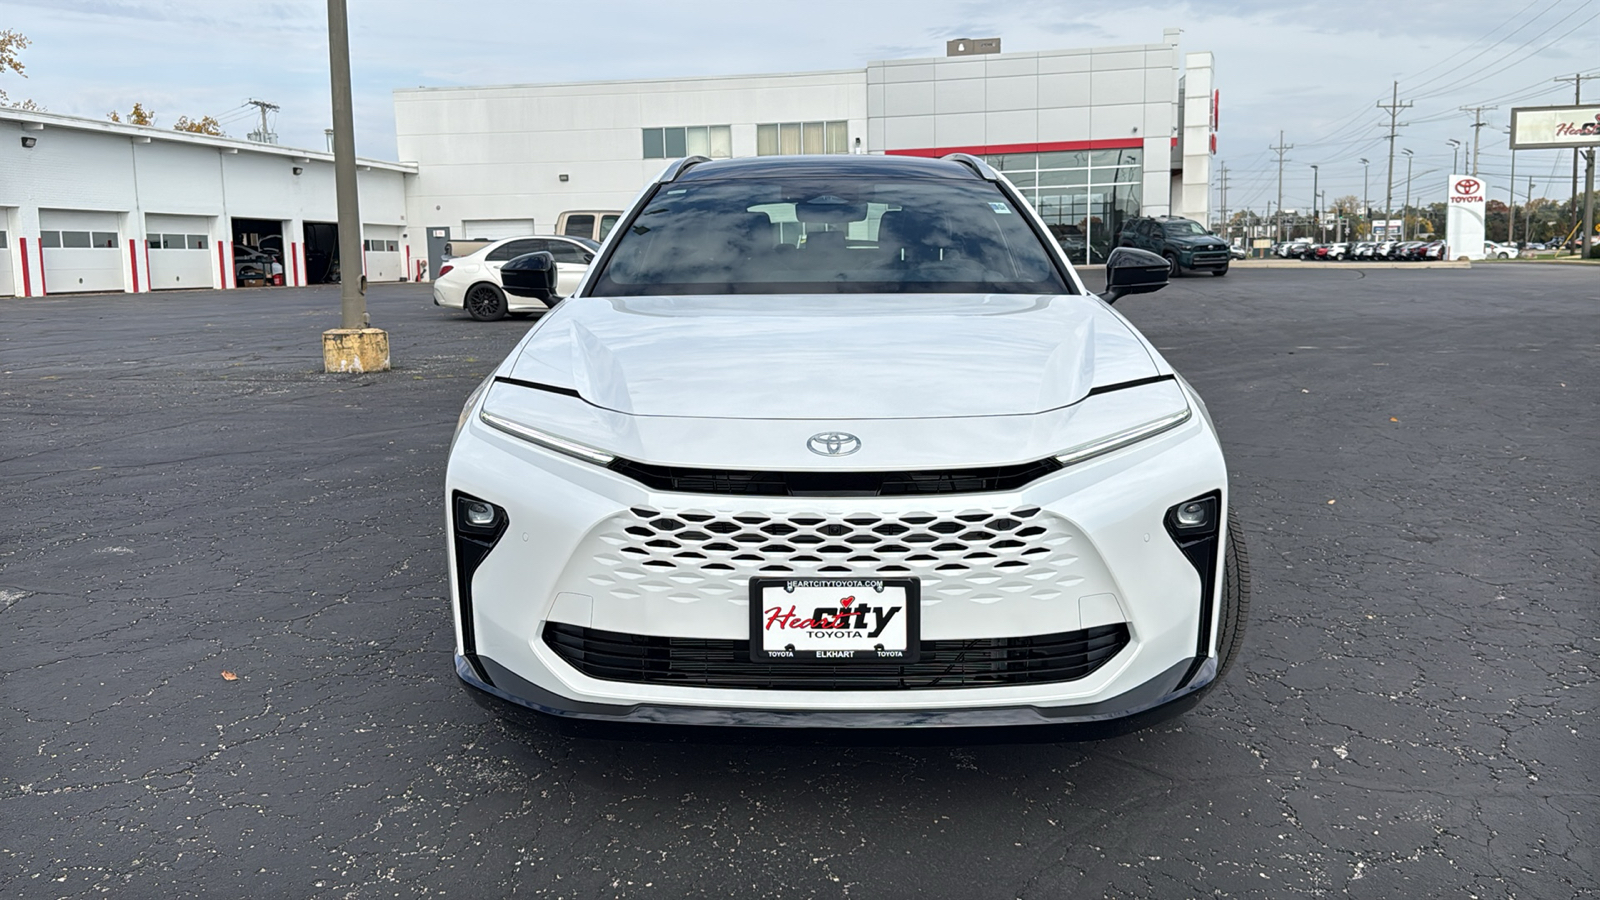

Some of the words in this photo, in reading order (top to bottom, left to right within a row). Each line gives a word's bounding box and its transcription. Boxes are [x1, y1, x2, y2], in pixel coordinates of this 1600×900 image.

[1450, 196, 1484, 204] TOYOTA
[764, 605, 862, 631] Heart
[810, 596, 903, 638] city
[816, 650, 855, 658] ELKHART
